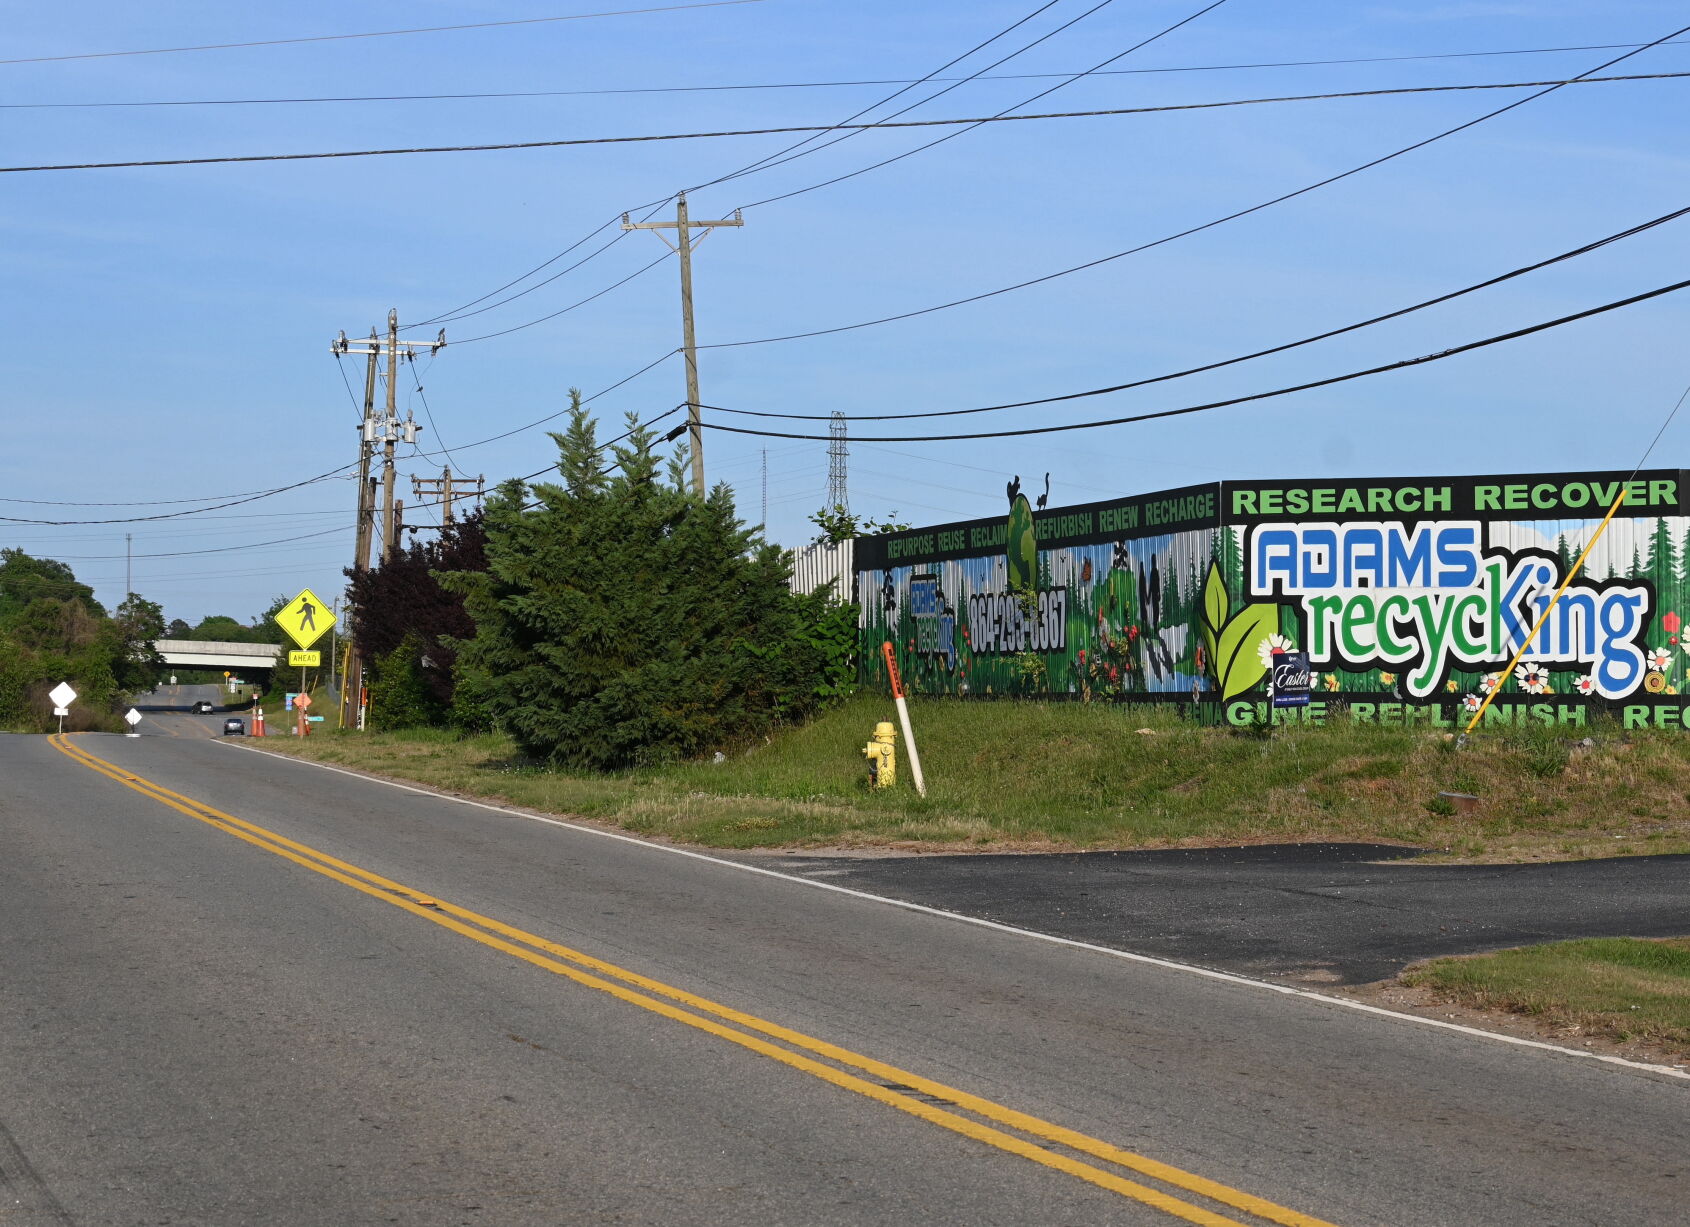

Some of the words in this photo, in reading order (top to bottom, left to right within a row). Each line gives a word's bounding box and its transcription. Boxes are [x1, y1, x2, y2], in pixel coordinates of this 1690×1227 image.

[1232, 487, 1452, 515] RESEARCH
[1474, 479, 1679, 511] RECOVER
[887, 534, 935, 560] REPURPOSE
[938, 529, 965, 551] REUSE
[970, 523, 1008, 549] RECLAIM
[1035, 512, 1093, 541] REFURBISH
[1099, 505, 1139, 533] RENEW
[1145, 493, 1215, 527] RECHARGE
[1257, 527, 1478, 589] ADAMS
[293, 654, 317, 662] AHEAD
[1275, 664, 1309, 688] Easter
